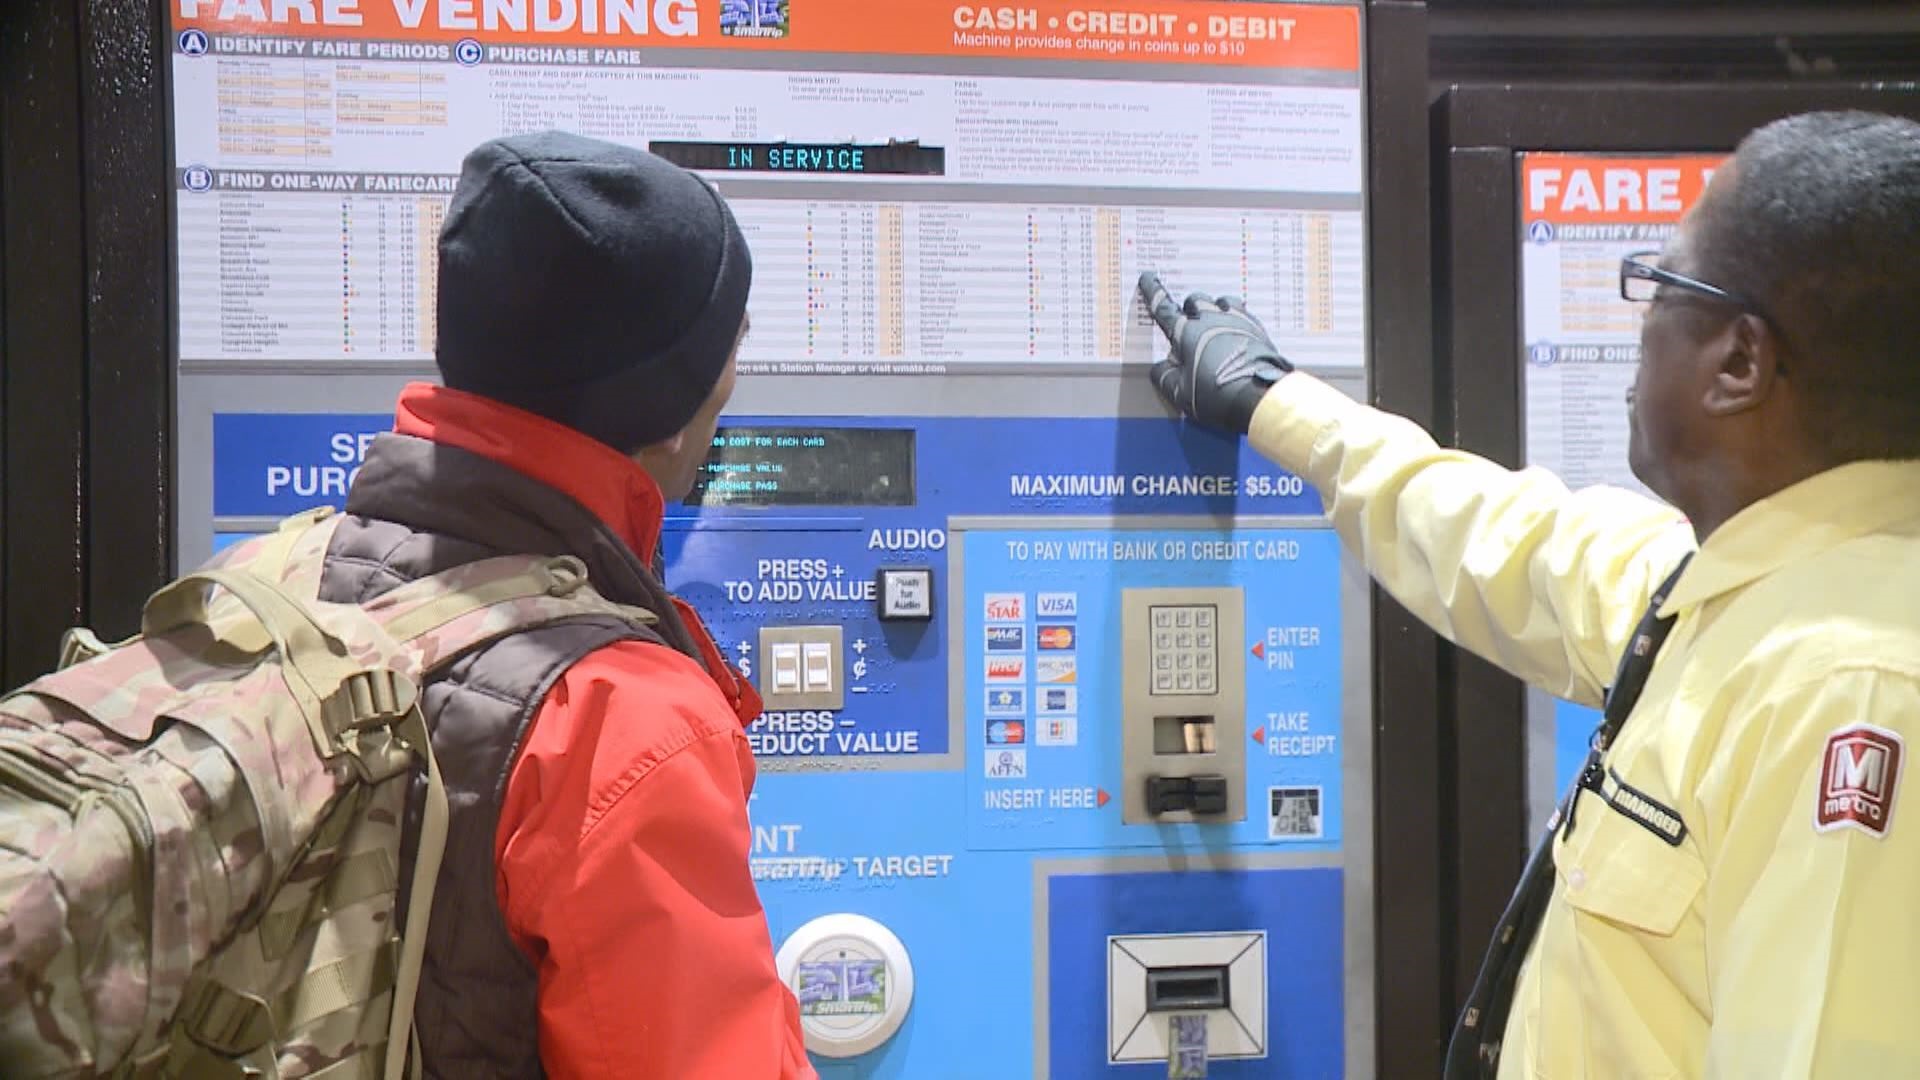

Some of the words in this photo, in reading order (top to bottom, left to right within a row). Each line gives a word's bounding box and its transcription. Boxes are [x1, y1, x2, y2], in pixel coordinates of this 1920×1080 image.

[953, 5, 1038, 31] CASH
[1066, 10, 1178, 38] CREDIT
[1208, 15, 1297, 41] DEBIT
[214, 37, 307, 55] IDENTIFY
[312, 40, 362, 57] FARE
[366, 43, 450, 60] PERIODS
[953, 31, 1011, 48] Machine
[1015, 34, 1072, 51] provides
[1075, 36, 1125, 54] change
[1129, 38, 1141, 50] in
[1144, 40, 1180, 53] coins
[1183, 41, 1200, 56] up
[1203, 41, 1216, 55] to
[1219, 40, 1246, 56] $10
[488, 46, 589, 64] PURCHASE
[594, 48, 641, 65] FARE
[728, 147, 752, 168] IN
[769, 149, 864, 170] SERVICE
[218, 172, 265, 189] FIND
[270, 174, 359, 191] ONE-WAY
[1529, 168, 1683, 212] FARE
[1558, 224, 1635, 242] IDENTIFY
[1560, 345, 1600, 362] FIND
[780, 363, 814, 373] Station
[816, 363, 856, 375] Manager
[729, 436, 752, 447] COST
[755, 436, 773, 447] FOR
[777, 436, 800, 447] EACH
[803, 437, 825, 447] CARD
[756, 481, 778, 491] PASS
[1010, 475, 1125, 496] MAXIMUM
[1131, 475, 1239, 497] CHANGE:
[1245, 474, 1303, 498] $5.00
[868, 528, 946, 550] AUDIO
[1007, 540, 1029, 561] TO
[1034, 541, 1062, 561] PAY
[1068, 541, 1108, 561] WITH
[1113, 541, 1157, 561] BANK
[1163, 541, 1186, 561] OR
[1191, 541, 1249, 561] CREDIT
[1255, 541, 1300, 561] CARD
[757, 559, 828, 580] PRESS
[724, 580, 753, 603] TO
[758, 580, 802, 602] ADD
[807, 580, 877, 602] VALUE
[987, 607, 1020, 619] STAR
[1042, 598, 1075, 611] VISA
[1267, 627, 1320, 647] ENTER
[1267, 650, 1294, 670] PIN
[751, 711, 835, 732] PRESS
[1267, 712, 1309, 732] TAKE
[835, 731, 919, 753] VALUE
[1268, 735, 1336, 756] RECEIPT
[1833, 744, 1884, 794] M
[984, 788, 1045, 810] INSERT
[1049, 787, 1094, 808] HERE
[1825, 795, 1881, 821] metro
[1613, 788, 1683, 838] MANAGER
[853, 854, 954, 877] TARGET
